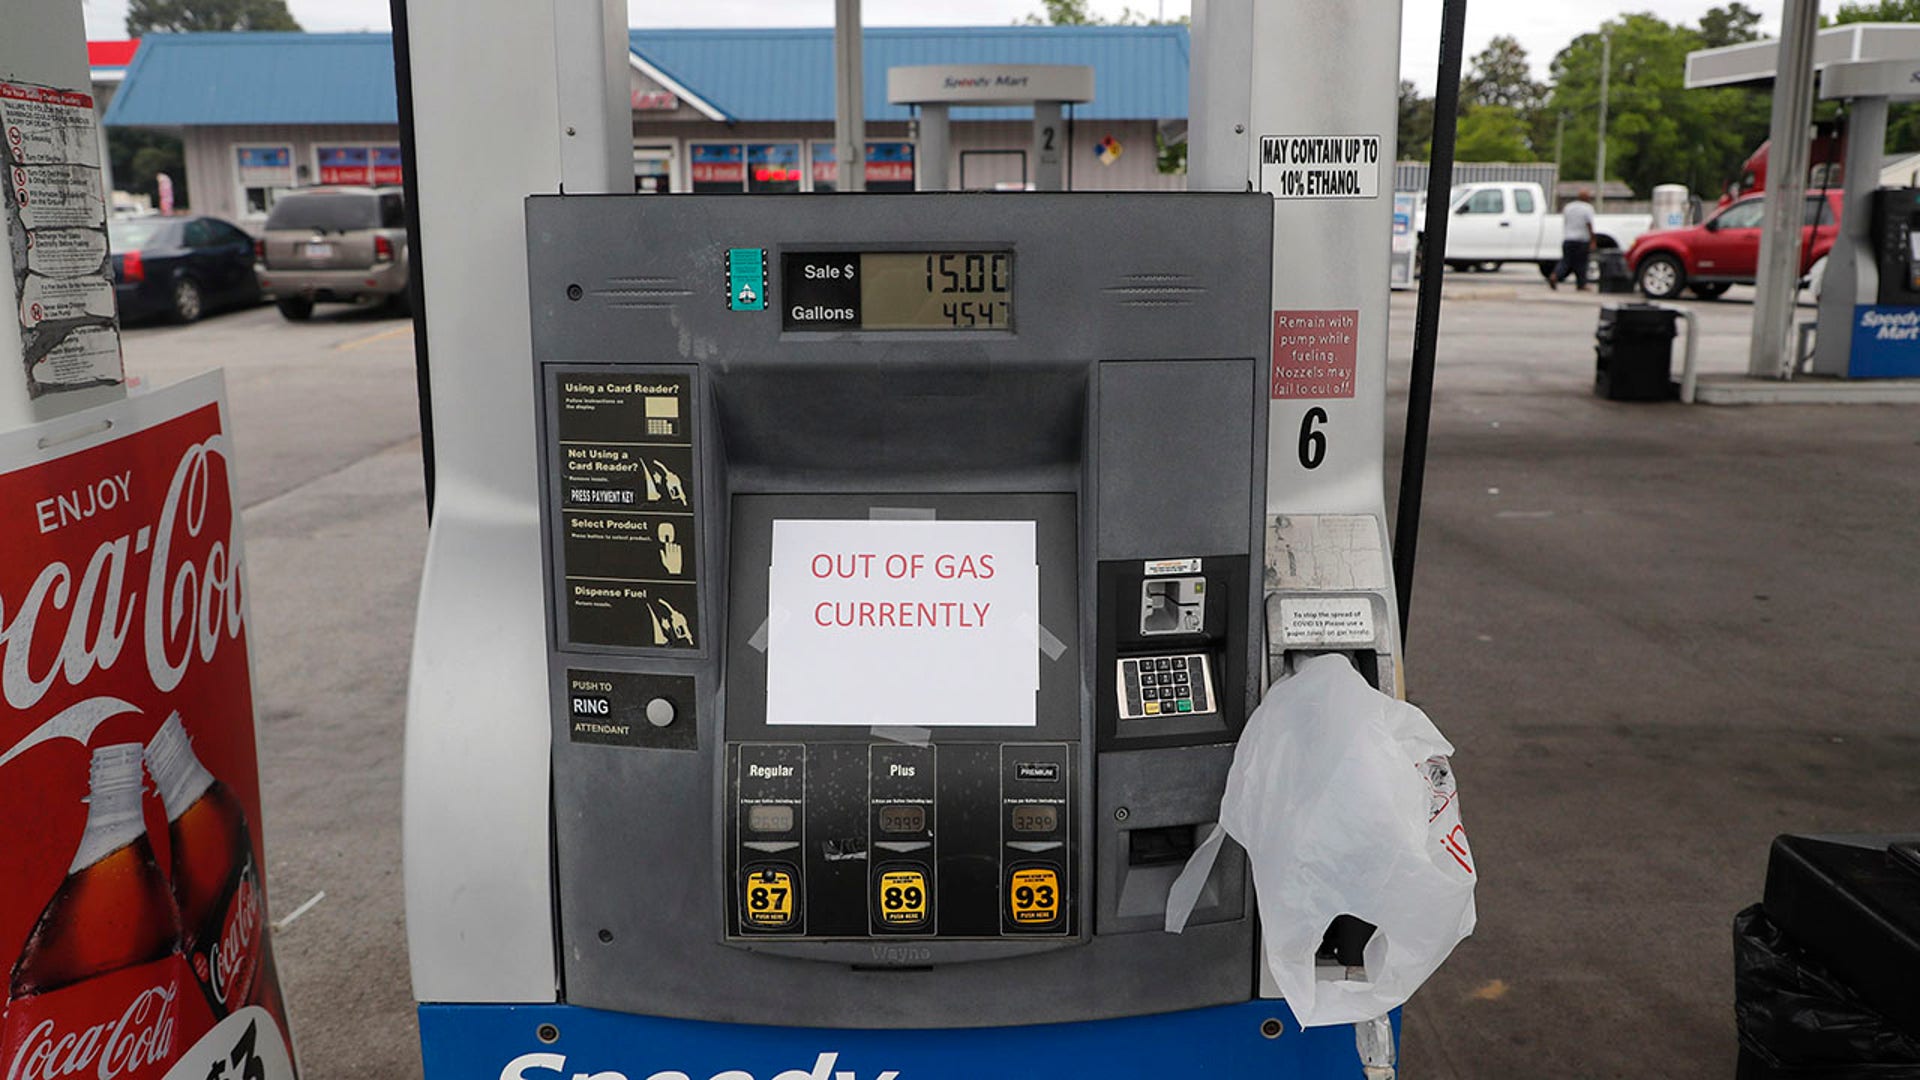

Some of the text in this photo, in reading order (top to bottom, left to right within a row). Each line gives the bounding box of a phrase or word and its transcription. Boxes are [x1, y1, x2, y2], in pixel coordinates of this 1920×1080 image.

[1043, 127, 1055, 151] 2
[1263, 138, 1378, 164] MAY CONTAIN UP TO
[1281, 170, 1361, 196] 10% ETHANOL
[804, 263, 855, 281] Sale $
[791, 305, 855, 321] Gallons
[1279, 315, 1354, 328] Remain with
[1280, 332, 1351, 347] pump while
[1292, 350, 1337, 363] fueling.
[1276, 367, 1351, 380] Nozzels may
[565, 383, 595, 394] Using
[607, 383, 632, 393] Card
[635, 384, 679, 394] Reader?
[1274, 382, 1293, 395] fail
[1296, 382, 1307, 394] to
[1311, 382, 1330, 394] cut
[1298, 406, 1328, 470] 6
[568, 449, 586, 459] Not
[589, 450, 619, 460] Using
[568, 461, 638, 472] Card Reader?
[36, 470, 132, 534] ENJOY
[571, 489, 634, 503] PRESS PAYMENT KEY
[571, 518, 648, 530] Select Product
[811, 554, 995, 579] OUT OF GAS
[575, 586, 647, 598] Dispense Fuel
[814, 602, 991, 628] CURRENTLY
[572, 680, 613, 692] PUSH TO
[573, 698, 609, 715] RING
[575, 722, 630, 735] ATTENDANT
[750, 764, 794, 779] Regular
[890, 764, 916, 777] Plus
[1020, 768, 1054, 777] PREMIUM
[750, 887, 788, 911] 87
[884, 886, 923, 910] 89
[1015, 885, 1055, 910] 93
